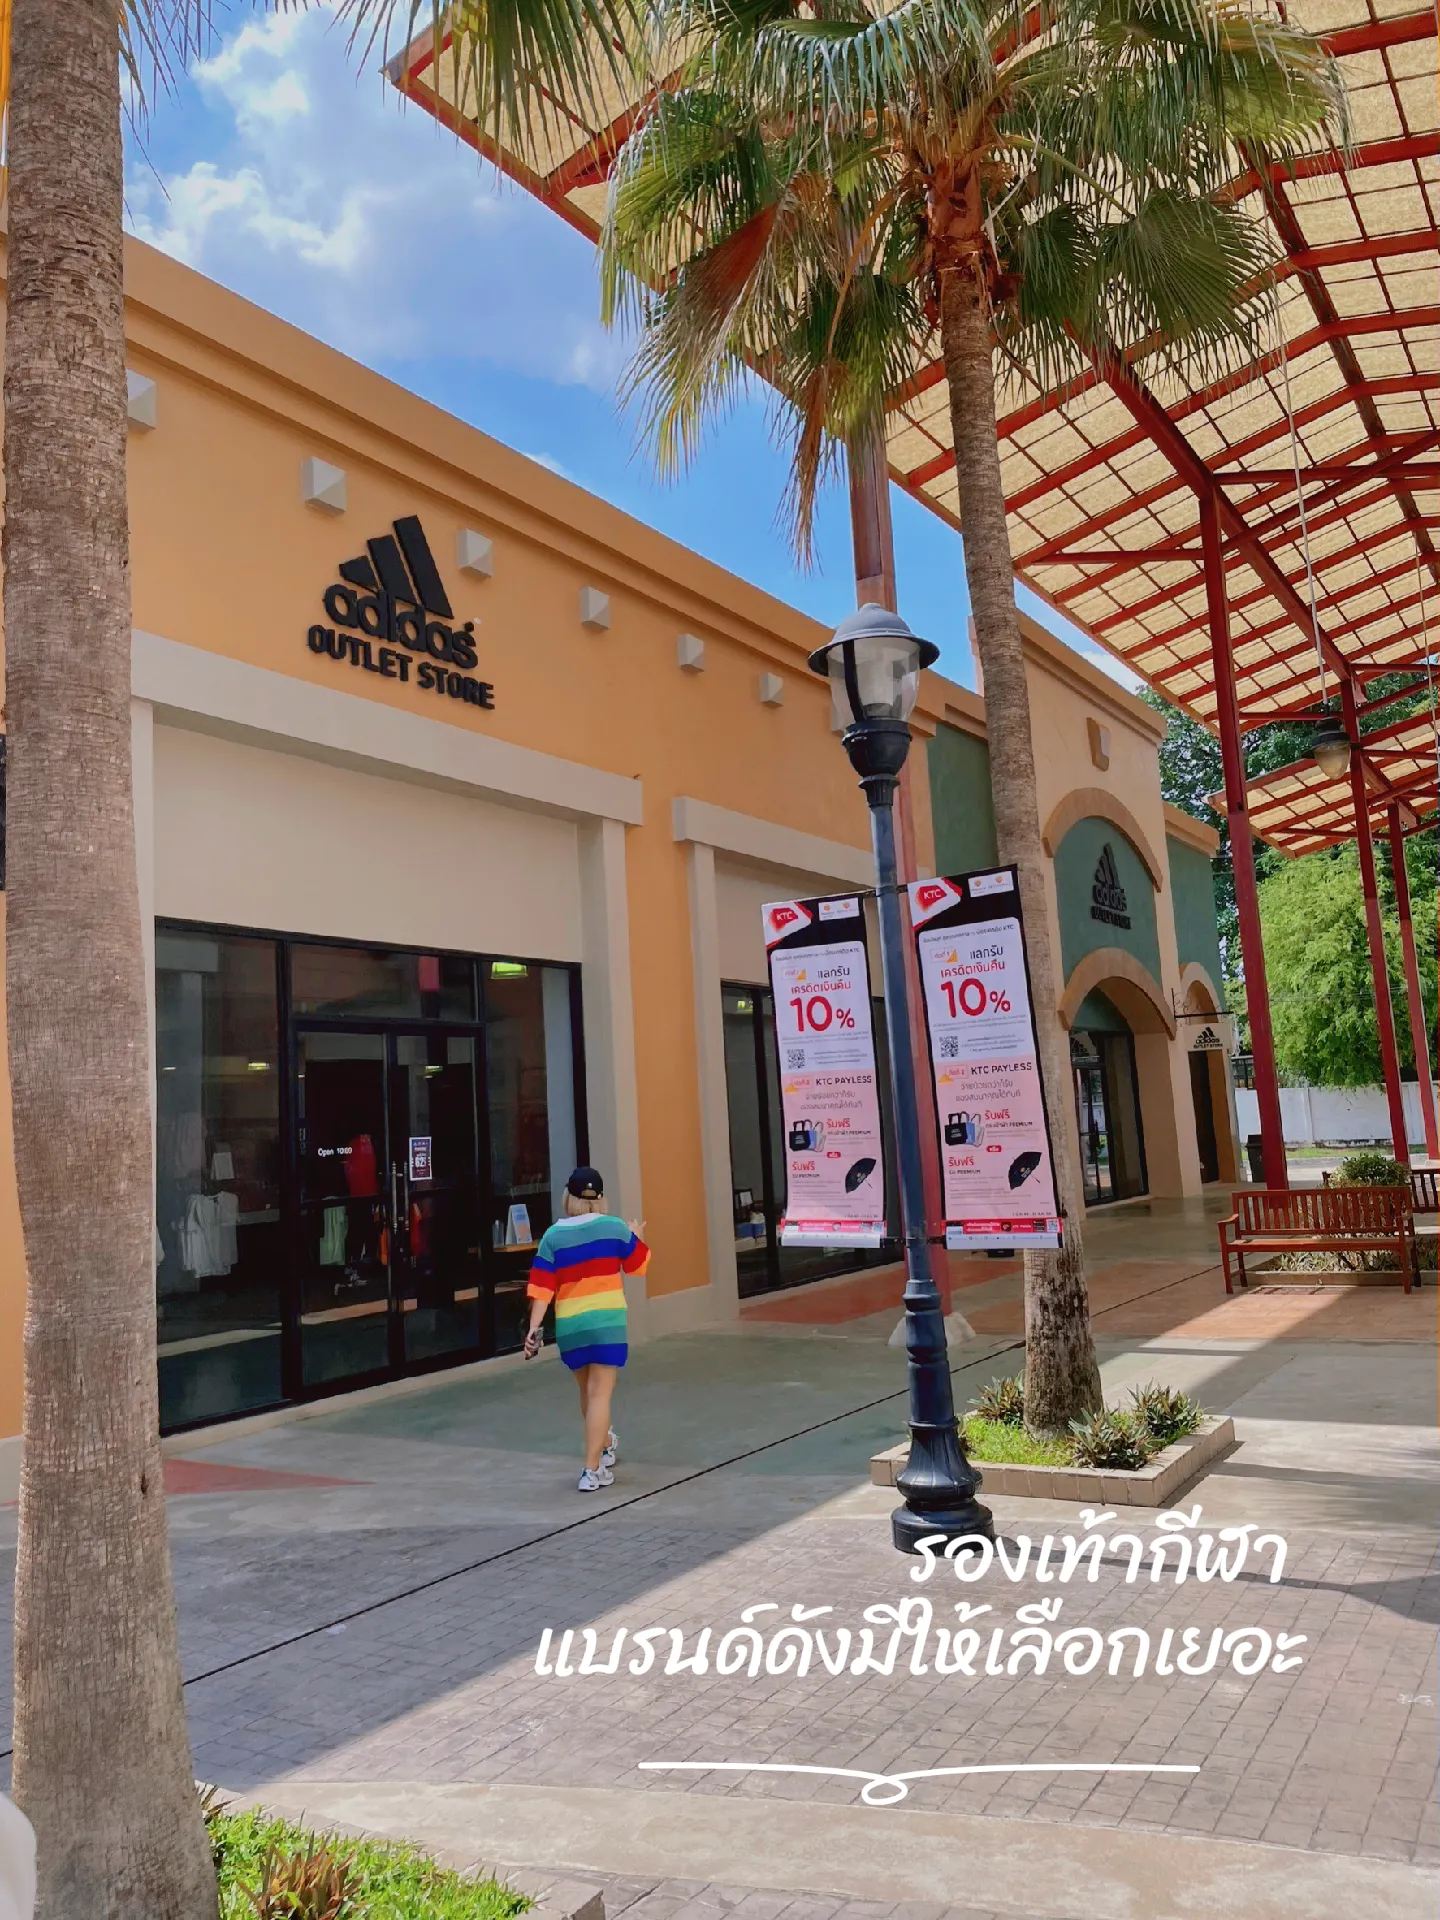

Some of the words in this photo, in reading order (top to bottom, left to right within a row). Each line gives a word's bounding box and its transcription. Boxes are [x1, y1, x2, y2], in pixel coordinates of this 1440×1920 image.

[323, 584, 479, 669] adidas
[307, 625, 413, 682] OUTLET
[417, 662, 495, 710] STORE
[923, 889, 941, 900] KTC
[1092, 883, 1127, 912] adidas
[776, 911, 793, 921] KTC
[969, 944, 1004, 960] แลกรับ
[817, 965, 851, 978] แลกรับ
[940, 958, 1006, 978] เครดิตเงินคืน
[791, 978, 852, 994] เครดิตเงินคืน
[940, 977, 1011, 1018] 10%
[789, 995, 855, 1032] 10%
[1196, 1037, 1220, 1045] adidas
[971, 1066, 989, 1075] KTC
[991, 1062, 1032, 1073] PAYLESS
[815, 1077, 833, 1086] KTC
[835, 1075, 872, 1085] PAYLESS
[984, 1109, 1011, 1120] รับฟรี
[827, 1118, 851, 1129] รับฟรี
[317, 1147, 334, 1158] Open
[791, 1161, 816, 1171] รับฟรี
[948, 1155, 975, 1167] รับฟรี
